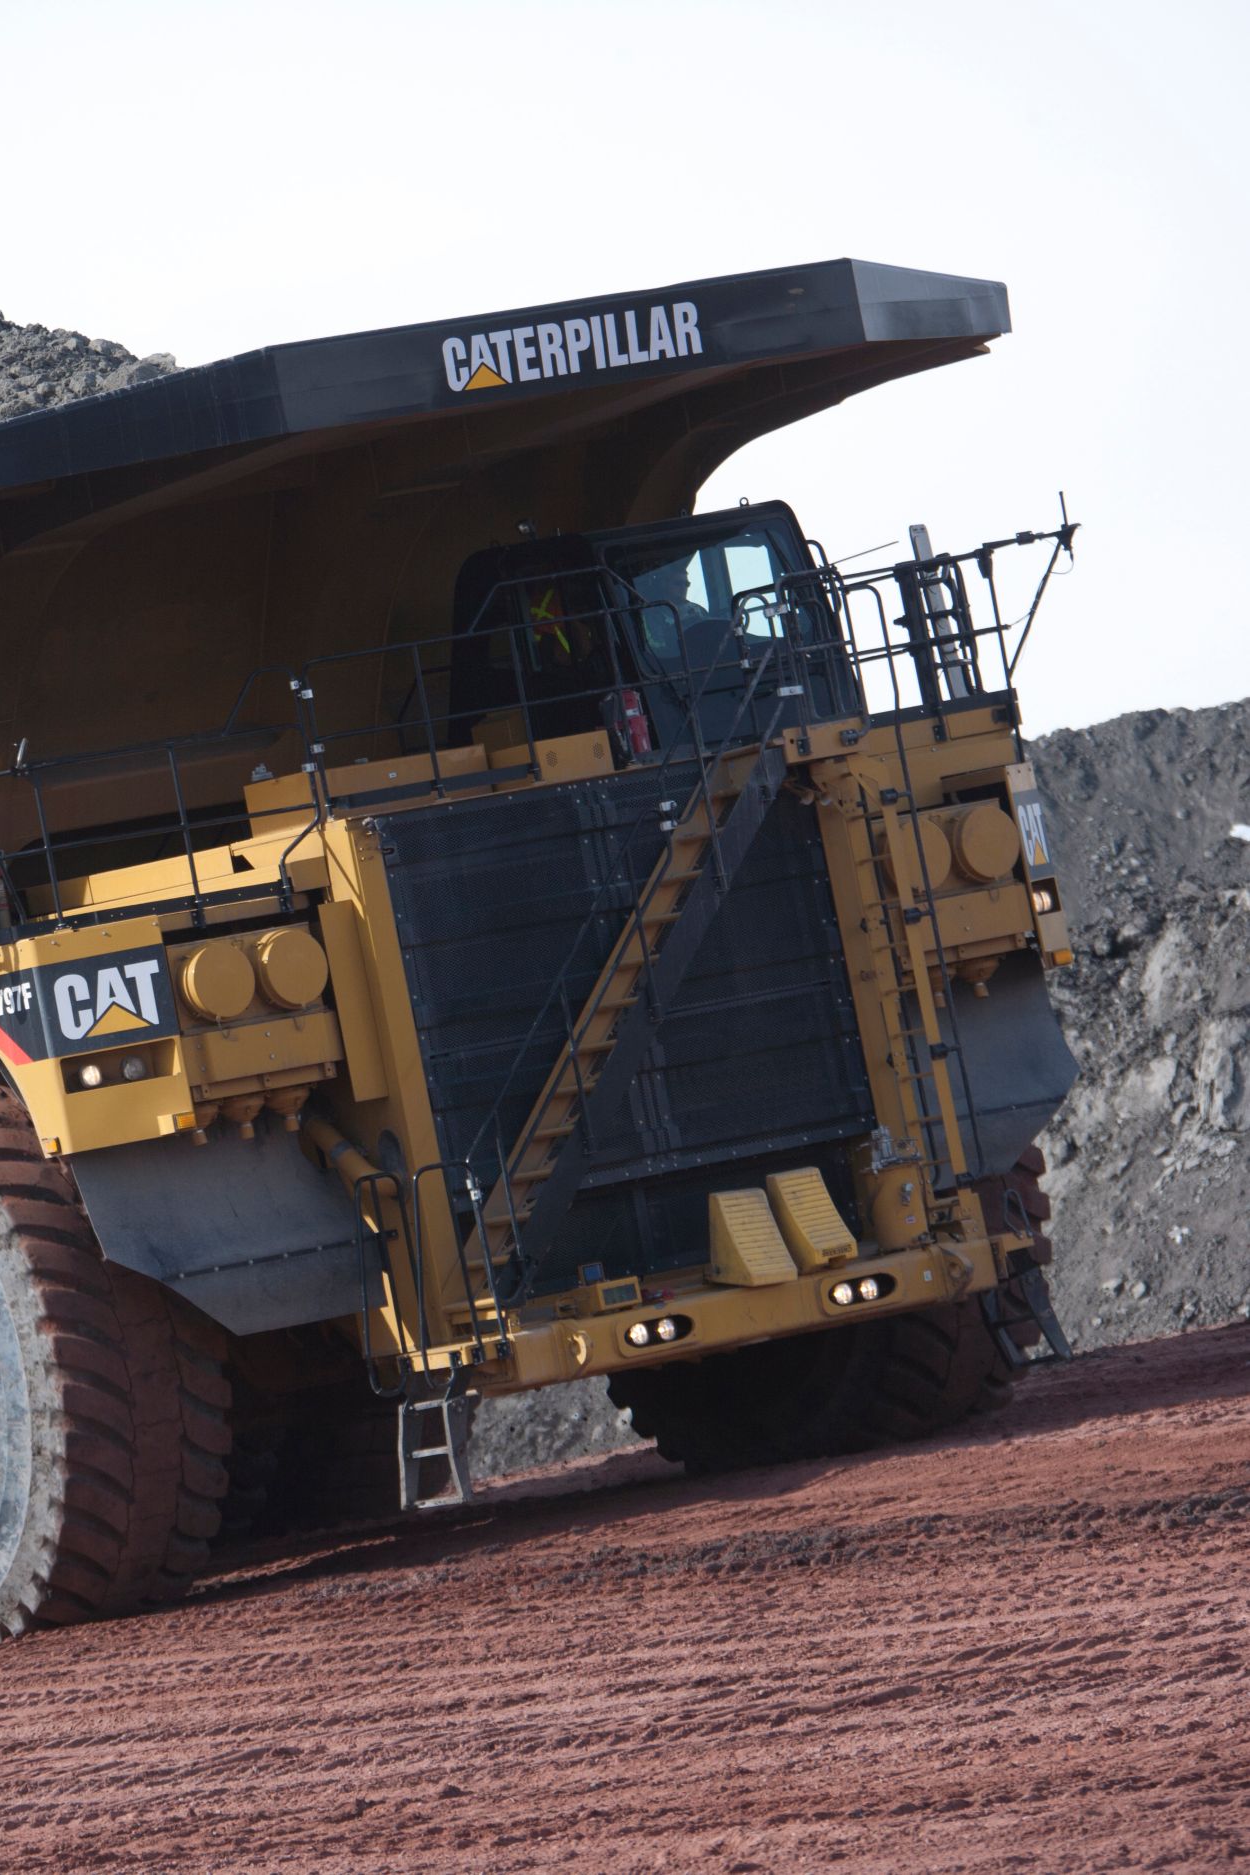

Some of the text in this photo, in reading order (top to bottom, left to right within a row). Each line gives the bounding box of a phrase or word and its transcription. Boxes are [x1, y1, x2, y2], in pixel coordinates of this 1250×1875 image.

[442, 301, 703, 392] CATERPILLAR
[1017, 803, 1050, 867] CAT
[53, 959, 160, 1040] CAT
